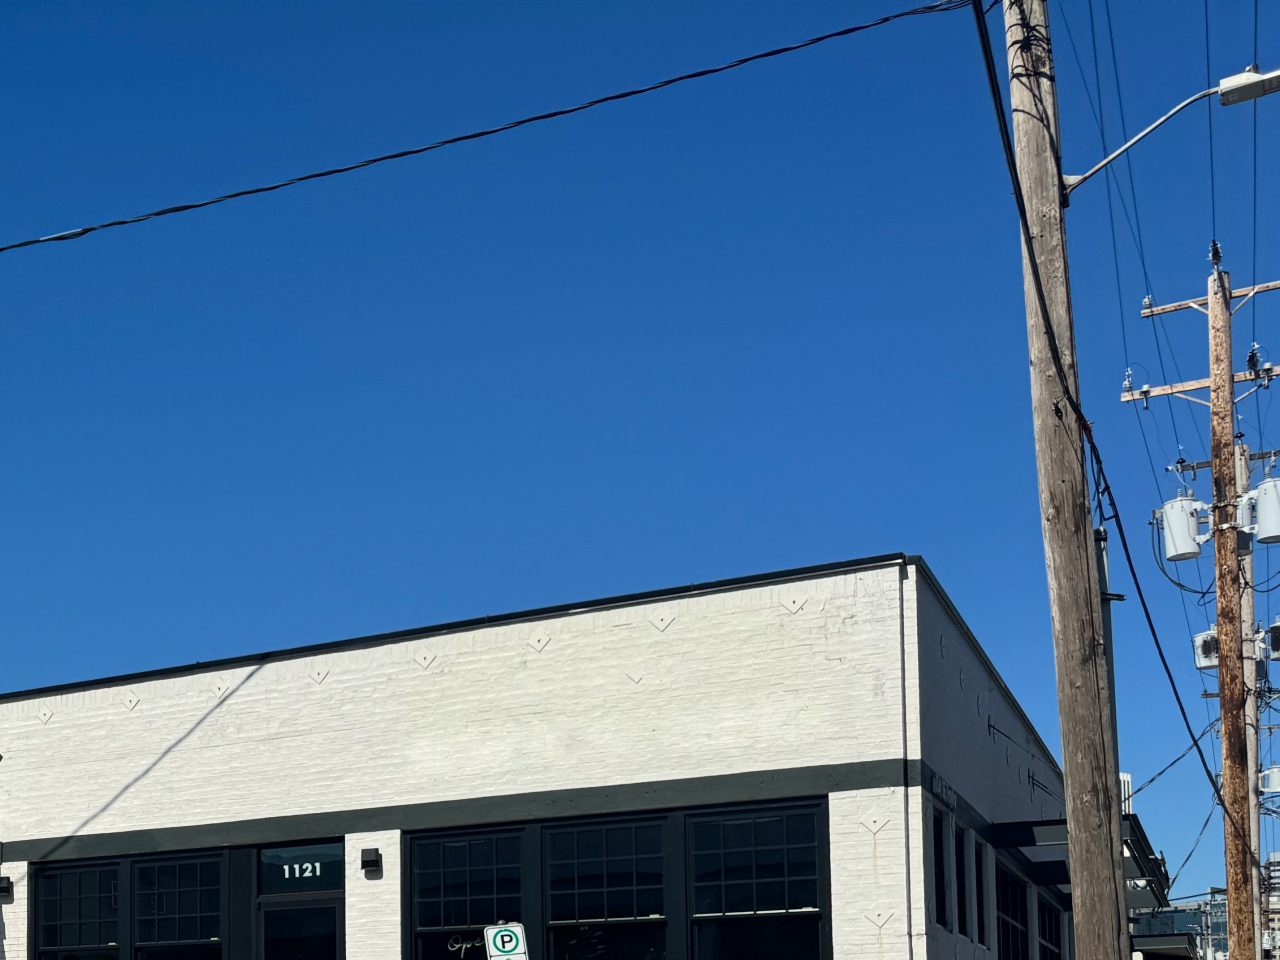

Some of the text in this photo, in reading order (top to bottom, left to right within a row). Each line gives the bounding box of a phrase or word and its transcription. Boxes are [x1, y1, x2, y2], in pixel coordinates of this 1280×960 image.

[282, 862, 322, 879] 1121
[447, 935, 485, 959] Ope
[500, 933, 513, 949] P
